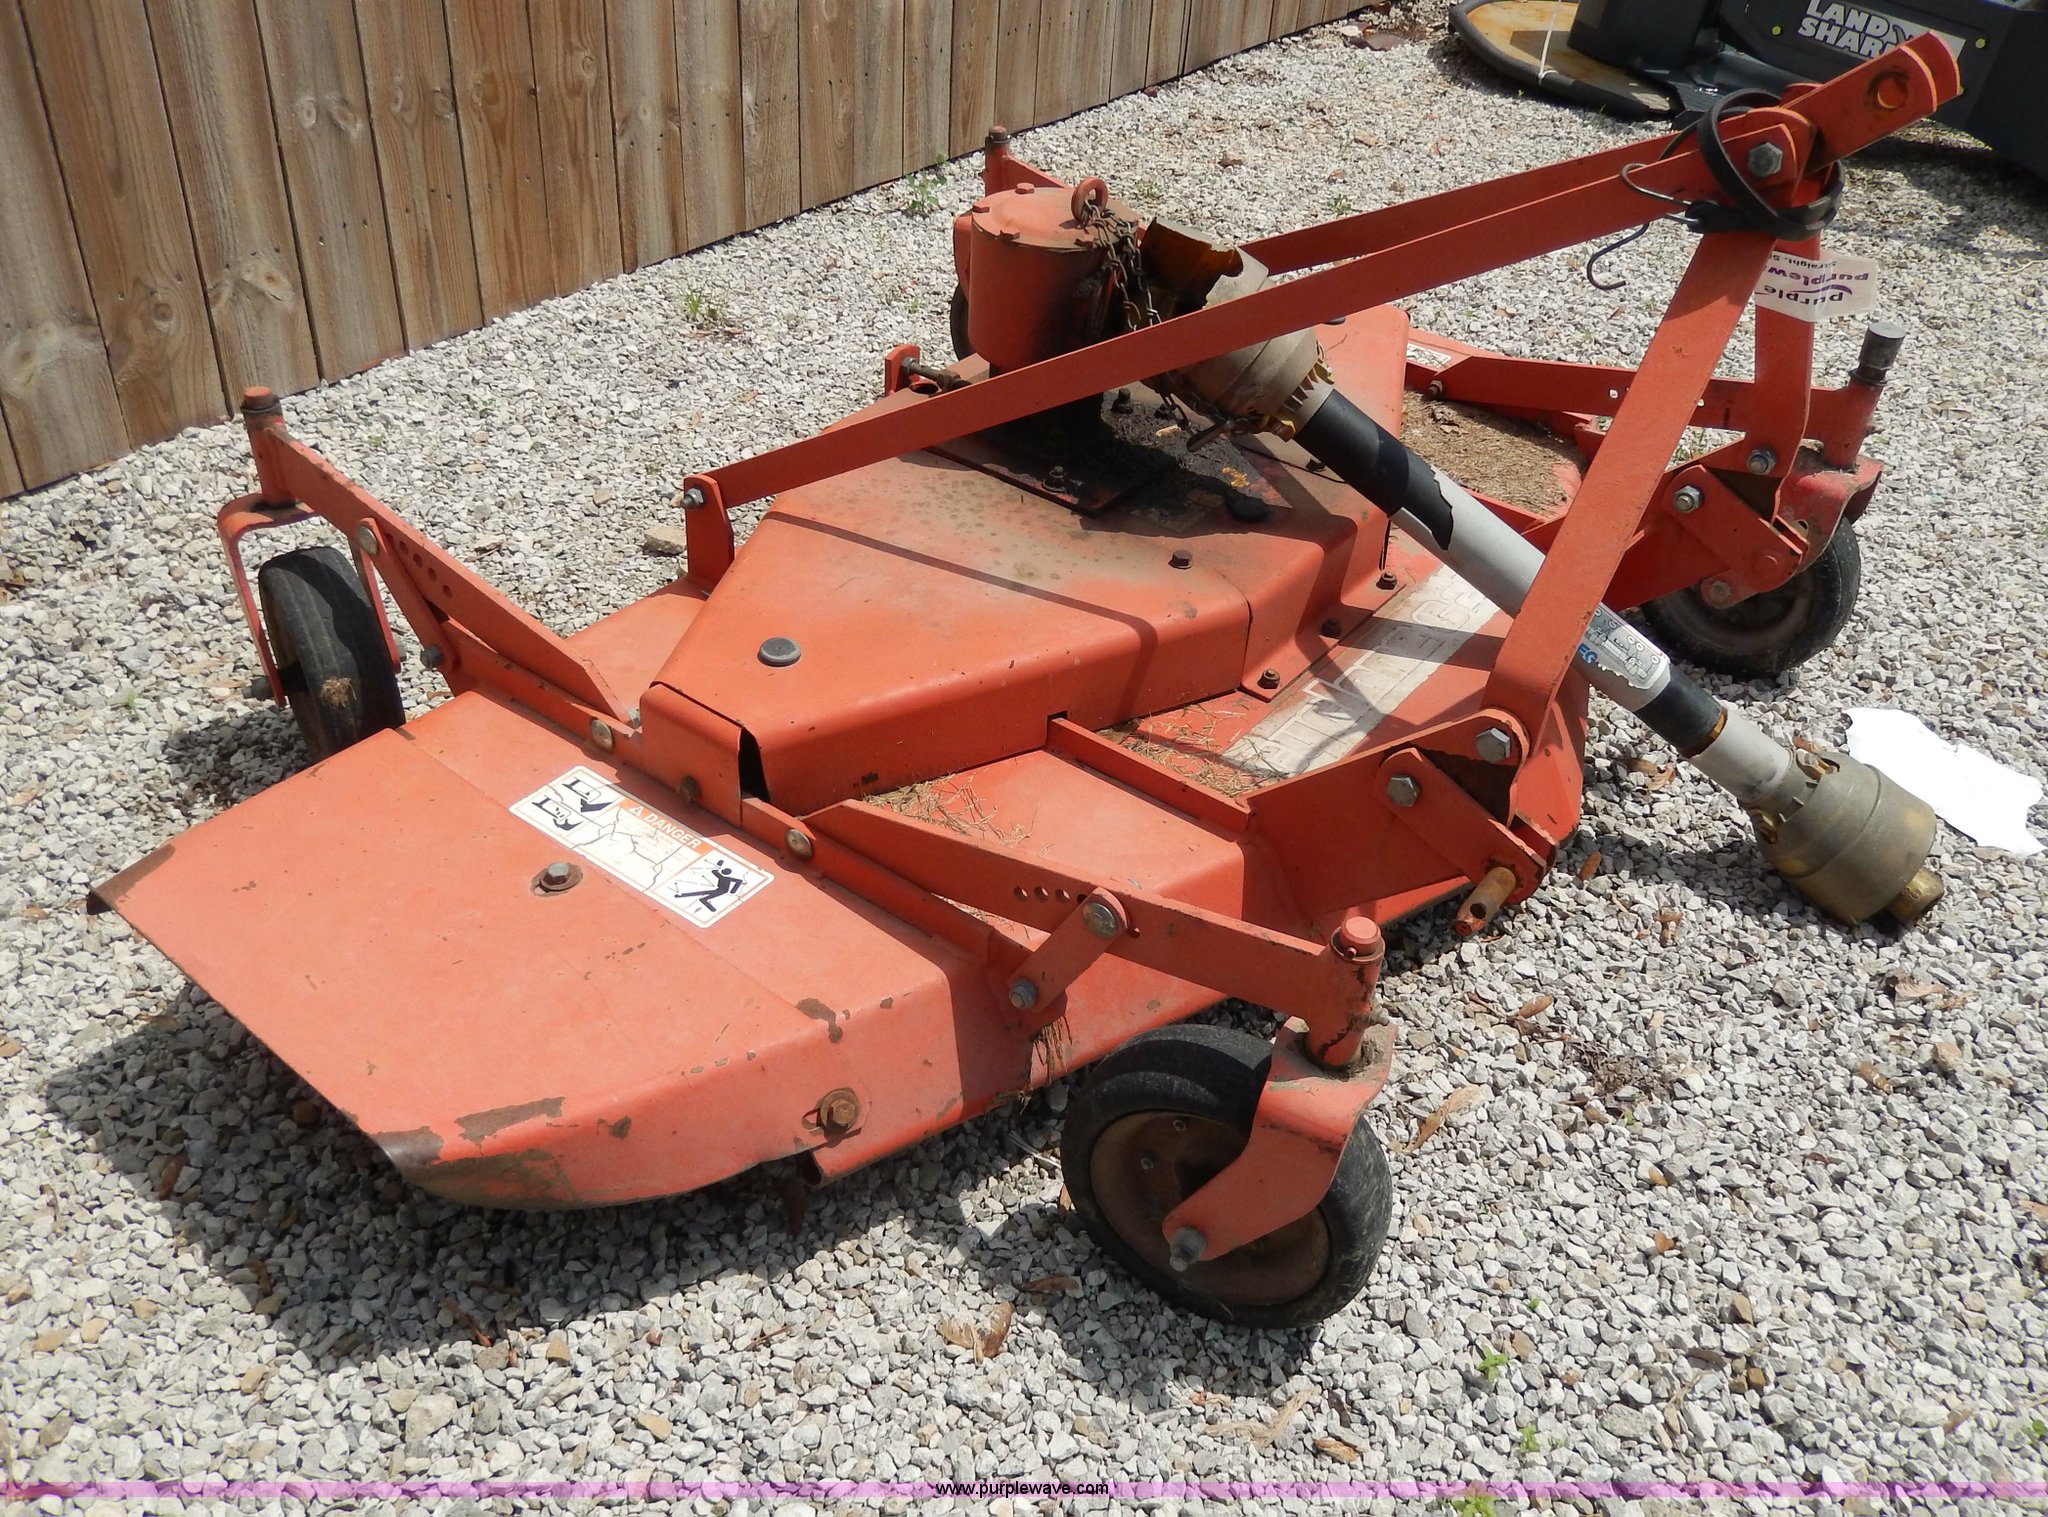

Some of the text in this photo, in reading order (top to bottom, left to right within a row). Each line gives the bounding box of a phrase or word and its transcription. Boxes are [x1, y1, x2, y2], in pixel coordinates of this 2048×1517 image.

[1798, 17, 1896, 58] SHAR
[1805, 0, 1891, 38] LAND
[1764, 265, 1869, 286] purplew
[1764, 284, 1844, 306] purple
[643, 806, 702, 849] DANGER
